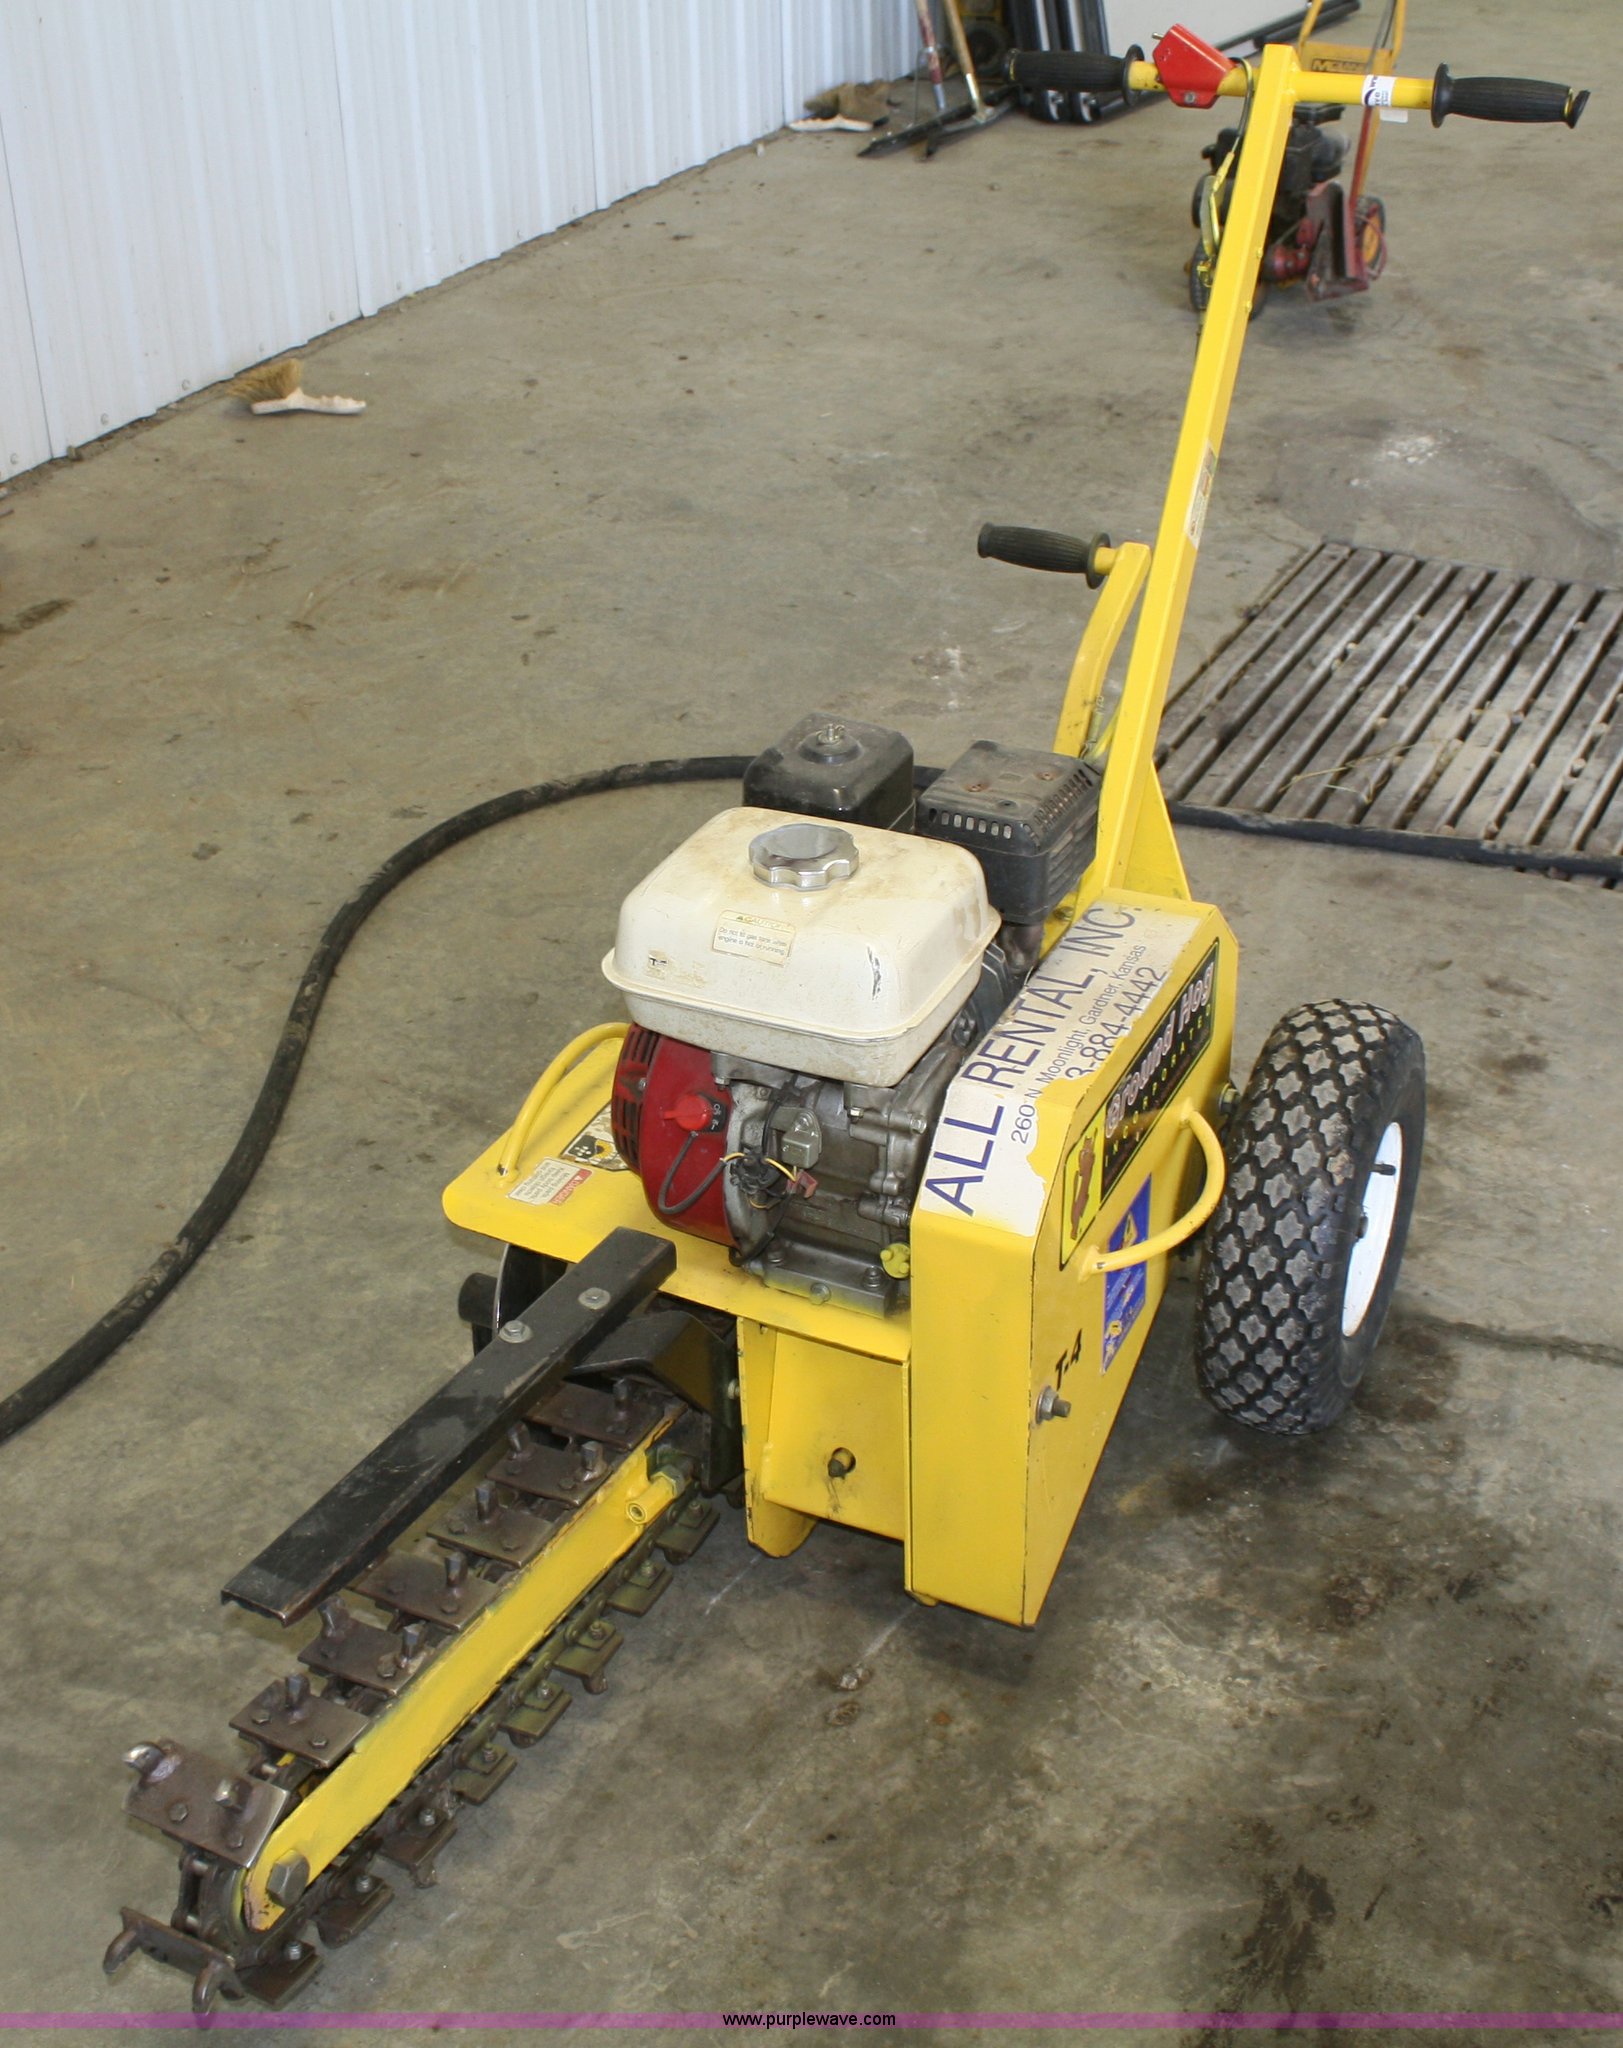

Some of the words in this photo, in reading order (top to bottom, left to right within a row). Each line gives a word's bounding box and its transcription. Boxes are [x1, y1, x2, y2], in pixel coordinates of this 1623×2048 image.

[961, 967, 1108, 1089] RENTAL,
[1010, 1104, 1036, 1144] 260
[1035, 1029, 1091, 1083] Moonlight,
[1079, 983, 1123, 1025] Gardner,
[1109, 945, 1147, 980] Kansas
[1105, 1009, 1176, 1138] Ground
[1178, 961, 1215, 1034] Hog
[925, 1105, 1005, 1217] ALL
